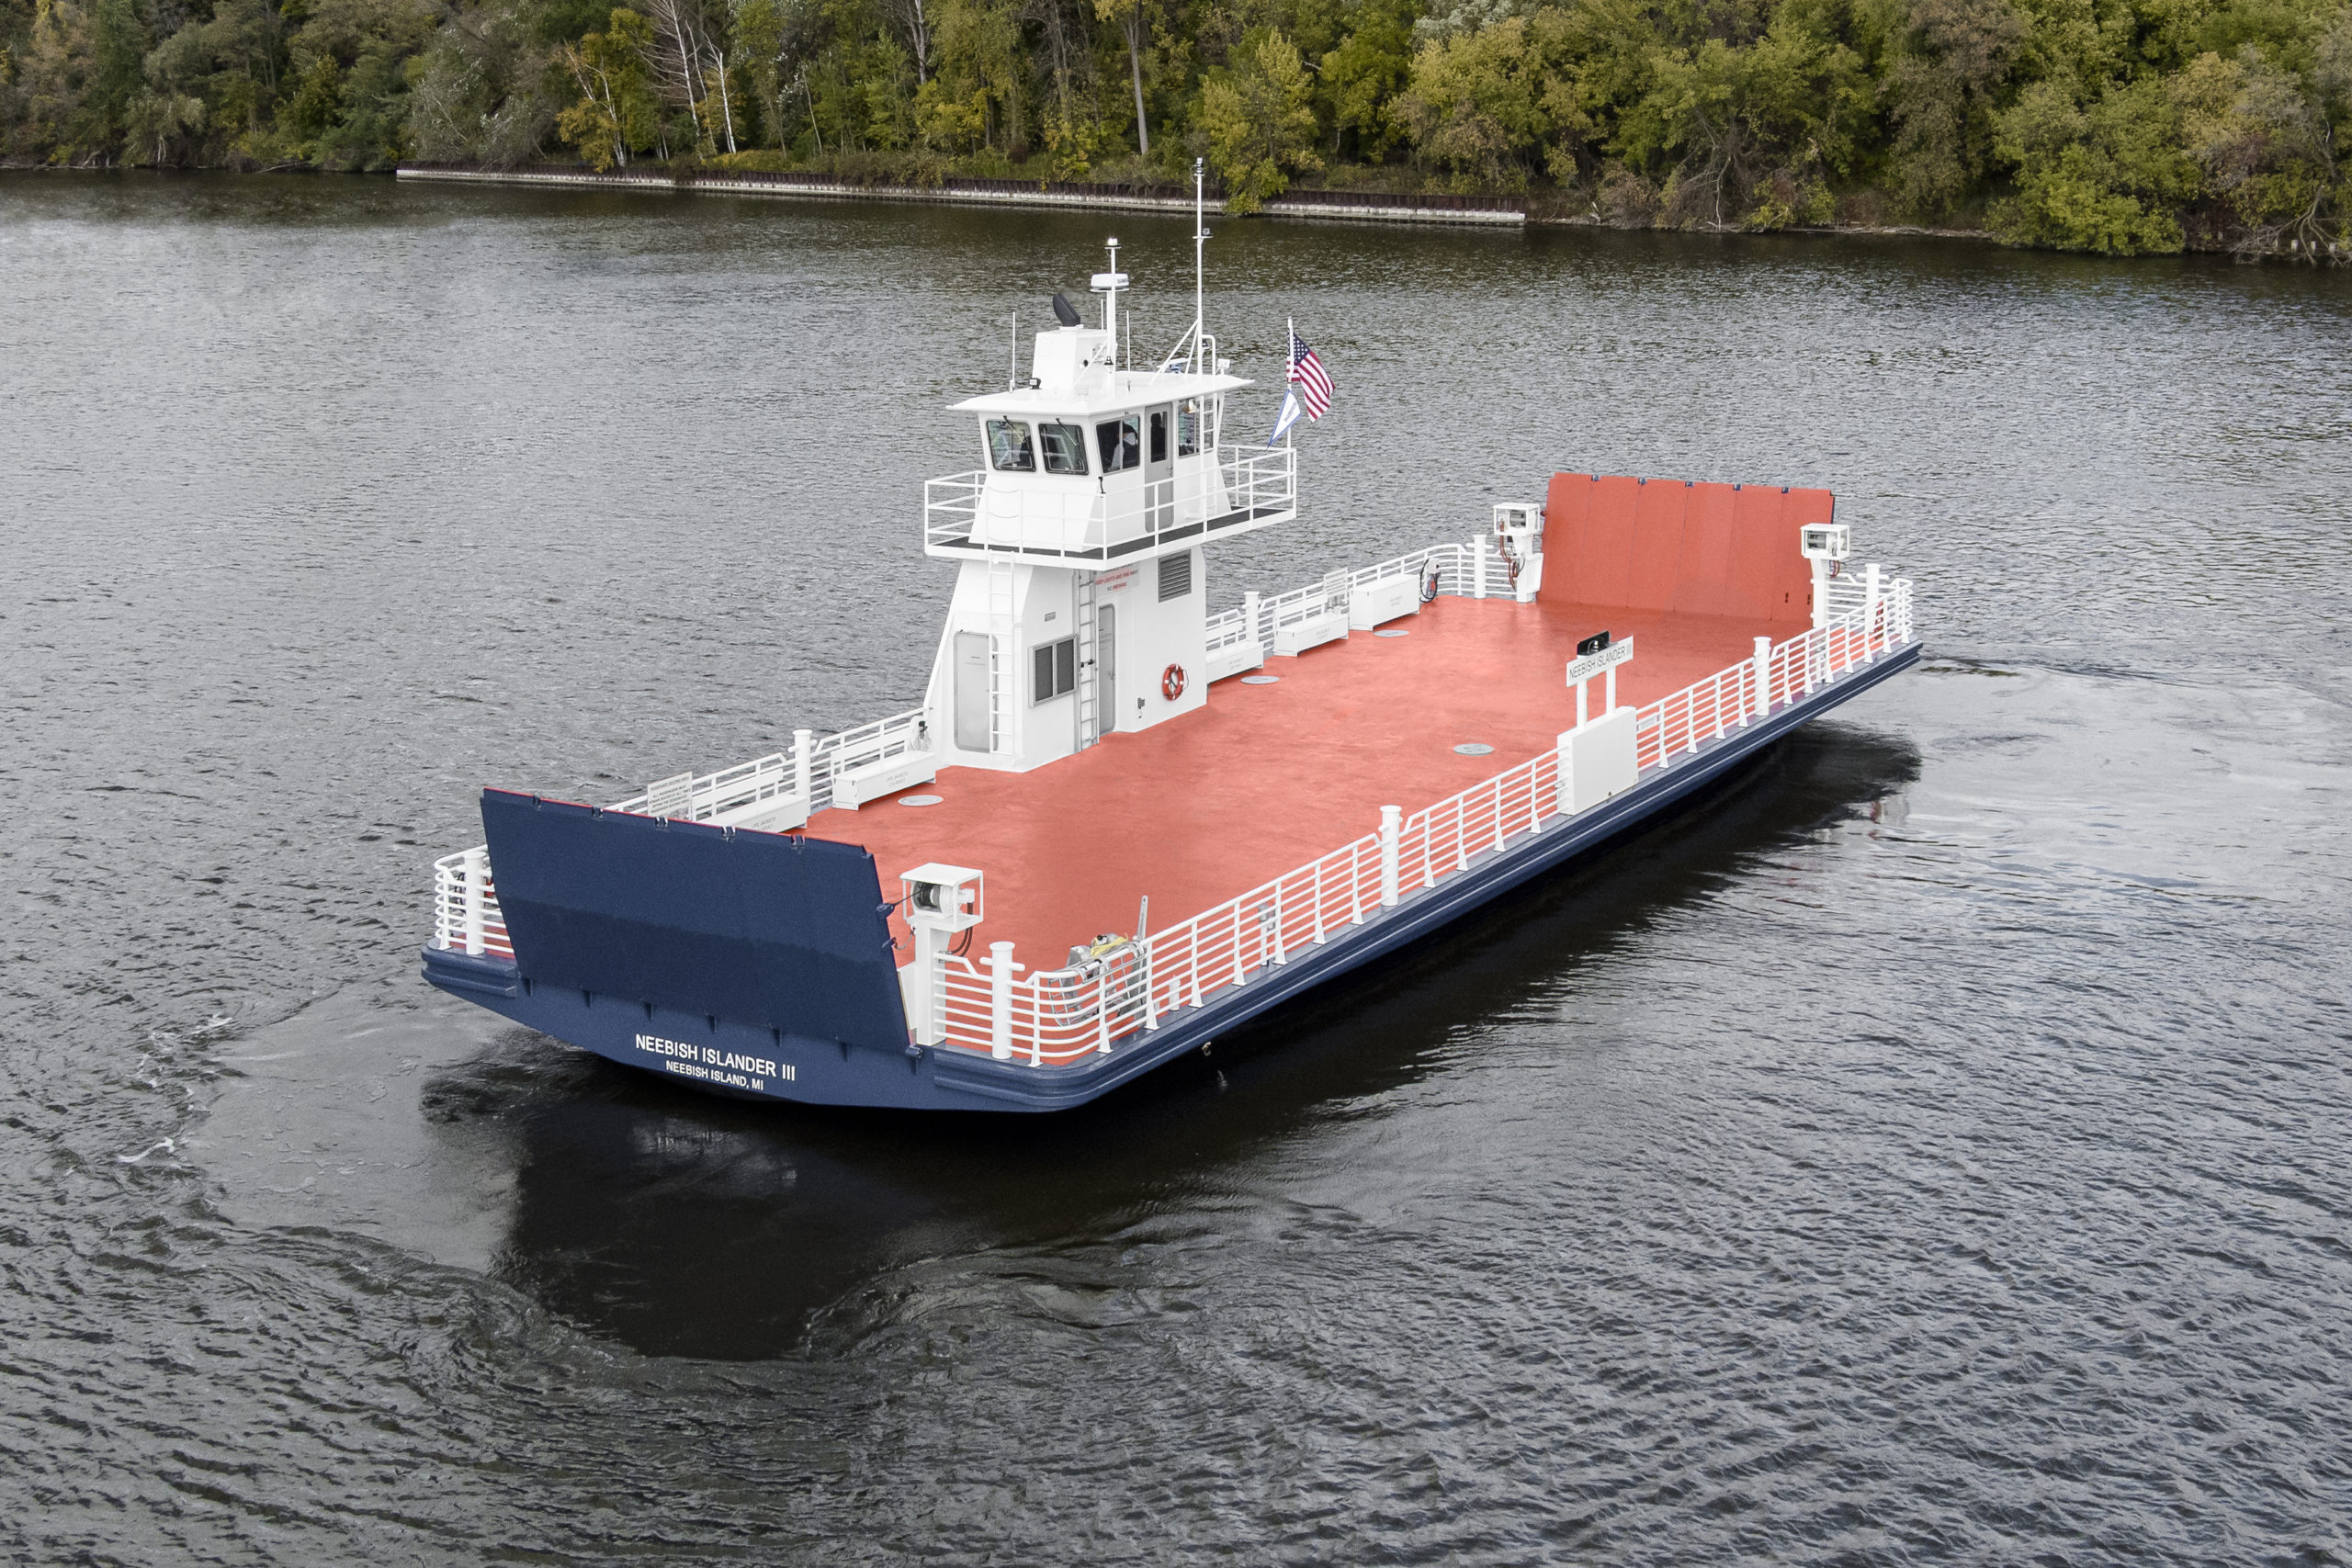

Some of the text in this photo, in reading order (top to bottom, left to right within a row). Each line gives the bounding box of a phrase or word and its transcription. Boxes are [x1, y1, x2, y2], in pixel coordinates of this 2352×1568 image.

[1569, 658, 1596, 680] NEEBISH
[1597, 646, 1626, 667] ISLANDER
[636, 1033, 796, 1081] NEEBISH ISLANDER III
[666, 1060, 764, 1091] NEEBISH ISLAND, MI
